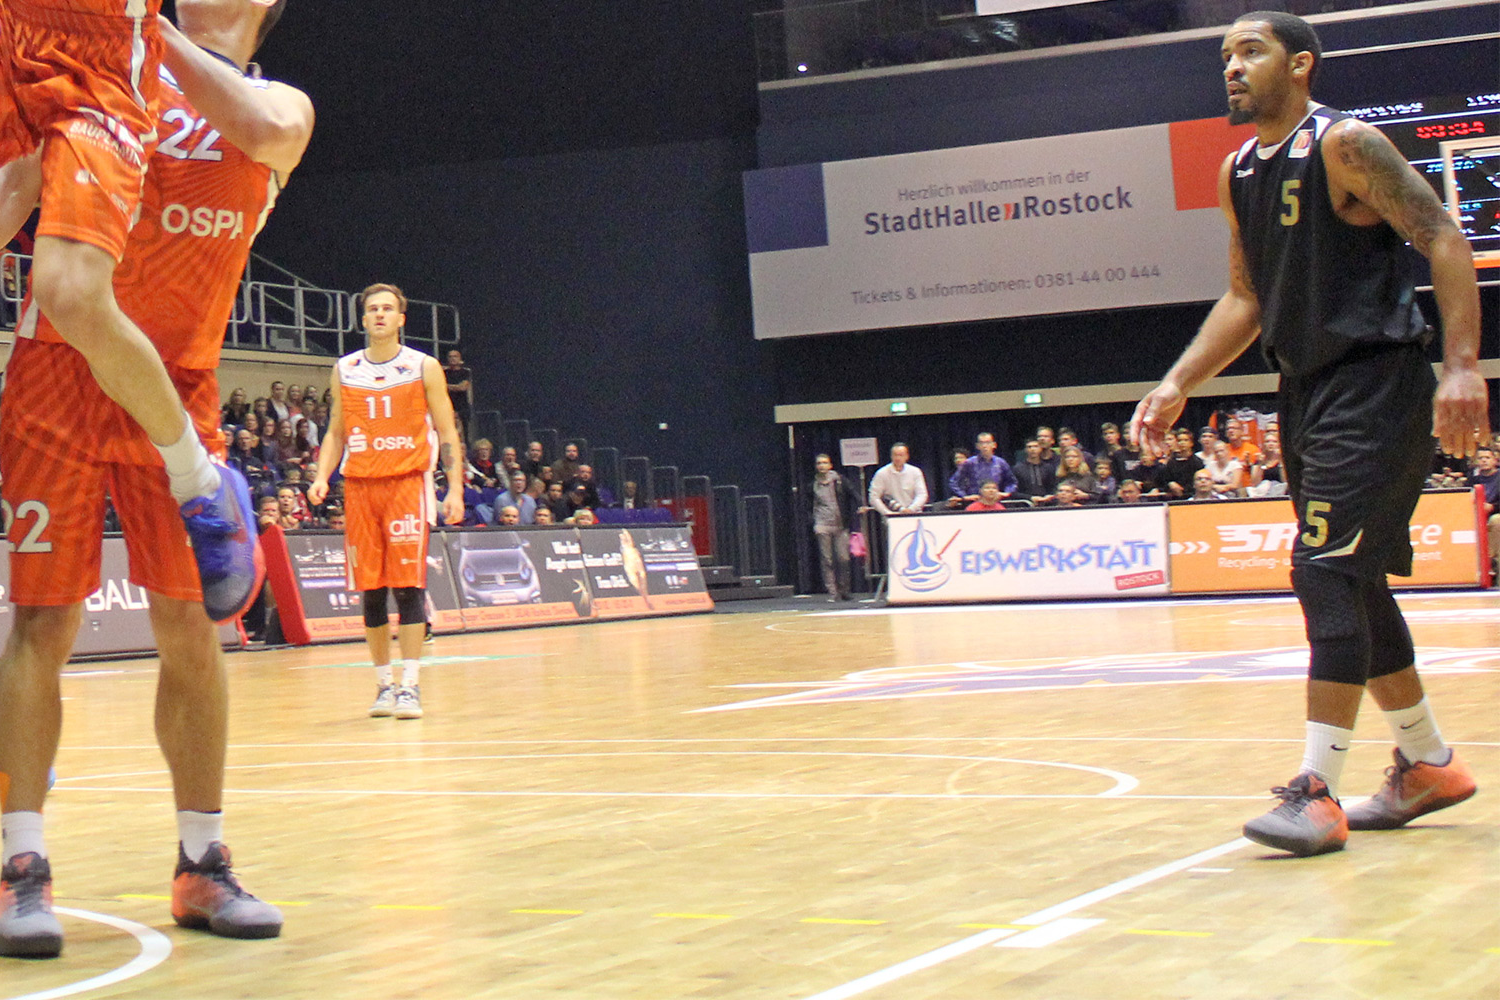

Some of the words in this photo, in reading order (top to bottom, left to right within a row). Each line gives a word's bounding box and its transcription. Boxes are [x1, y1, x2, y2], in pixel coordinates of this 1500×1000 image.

[897, 184, 954, 201] Herzlich
[957, 176, 1045, 196] willkommen
[1048, 172, 1062, 185] in
[1065, 170, 1091, 184] der
[864, 200, 1001, 235] StadtHalle
[1023, 186, 1133, 218] Rostock
[1280, 179, 1301, 226] 5
[851, 288, 902, 305] Tickets
[905, 287, 917, 300] &
[921, 278, 1031, 298] Informationen:
[1034, 271, 1100, 288] 0381-44
[1105, 268, 1126, 281] 00
[1130, 264, 1161, 278] 444
[365, 395, 392, 419] 11
[373, 436, 416, 450] OSPA
[1301, 501, 1331, 547] 5
[960, 540, 1157, 575] EISWERKSTATT
[1217, 556, 1280, 570] Recycling-
[1118, 573, 1159, 588] ROSTOCK
